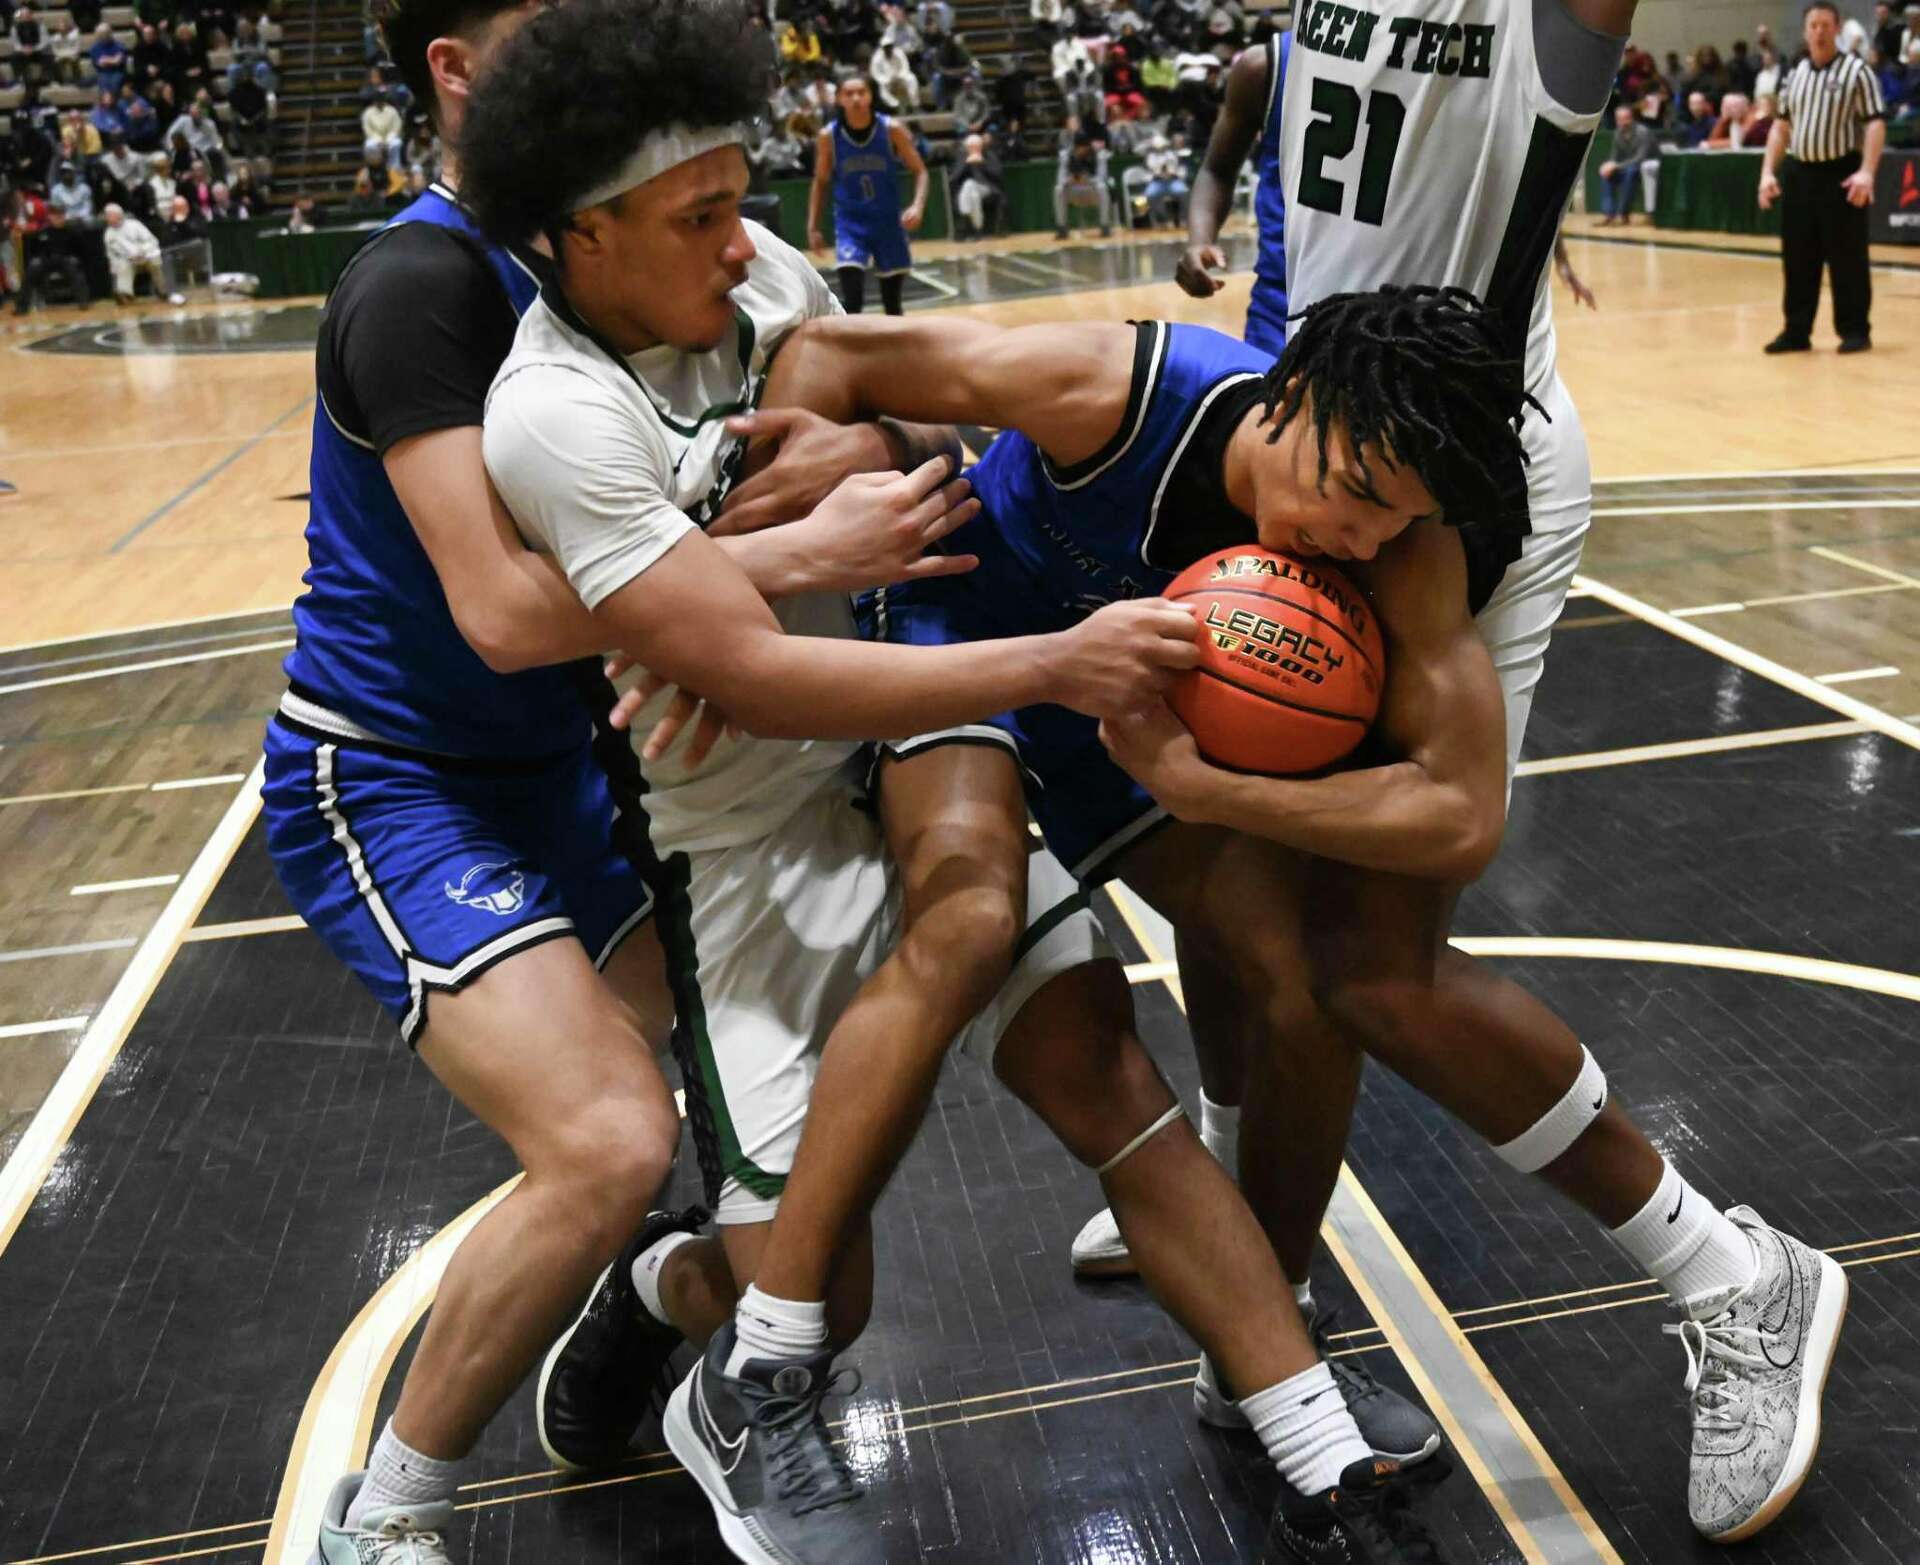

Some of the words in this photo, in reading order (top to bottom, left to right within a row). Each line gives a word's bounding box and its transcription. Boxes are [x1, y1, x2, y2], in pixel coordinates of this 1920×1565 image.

[1386, 17, 1495, 78] TECH
[1297, 77, 1406, 226] 21
[1209, 555, 1366, 635] SPALDING
[1204, 600, 1345, 672] LEGACY
[1241, 641, 1325, 685] 1000
